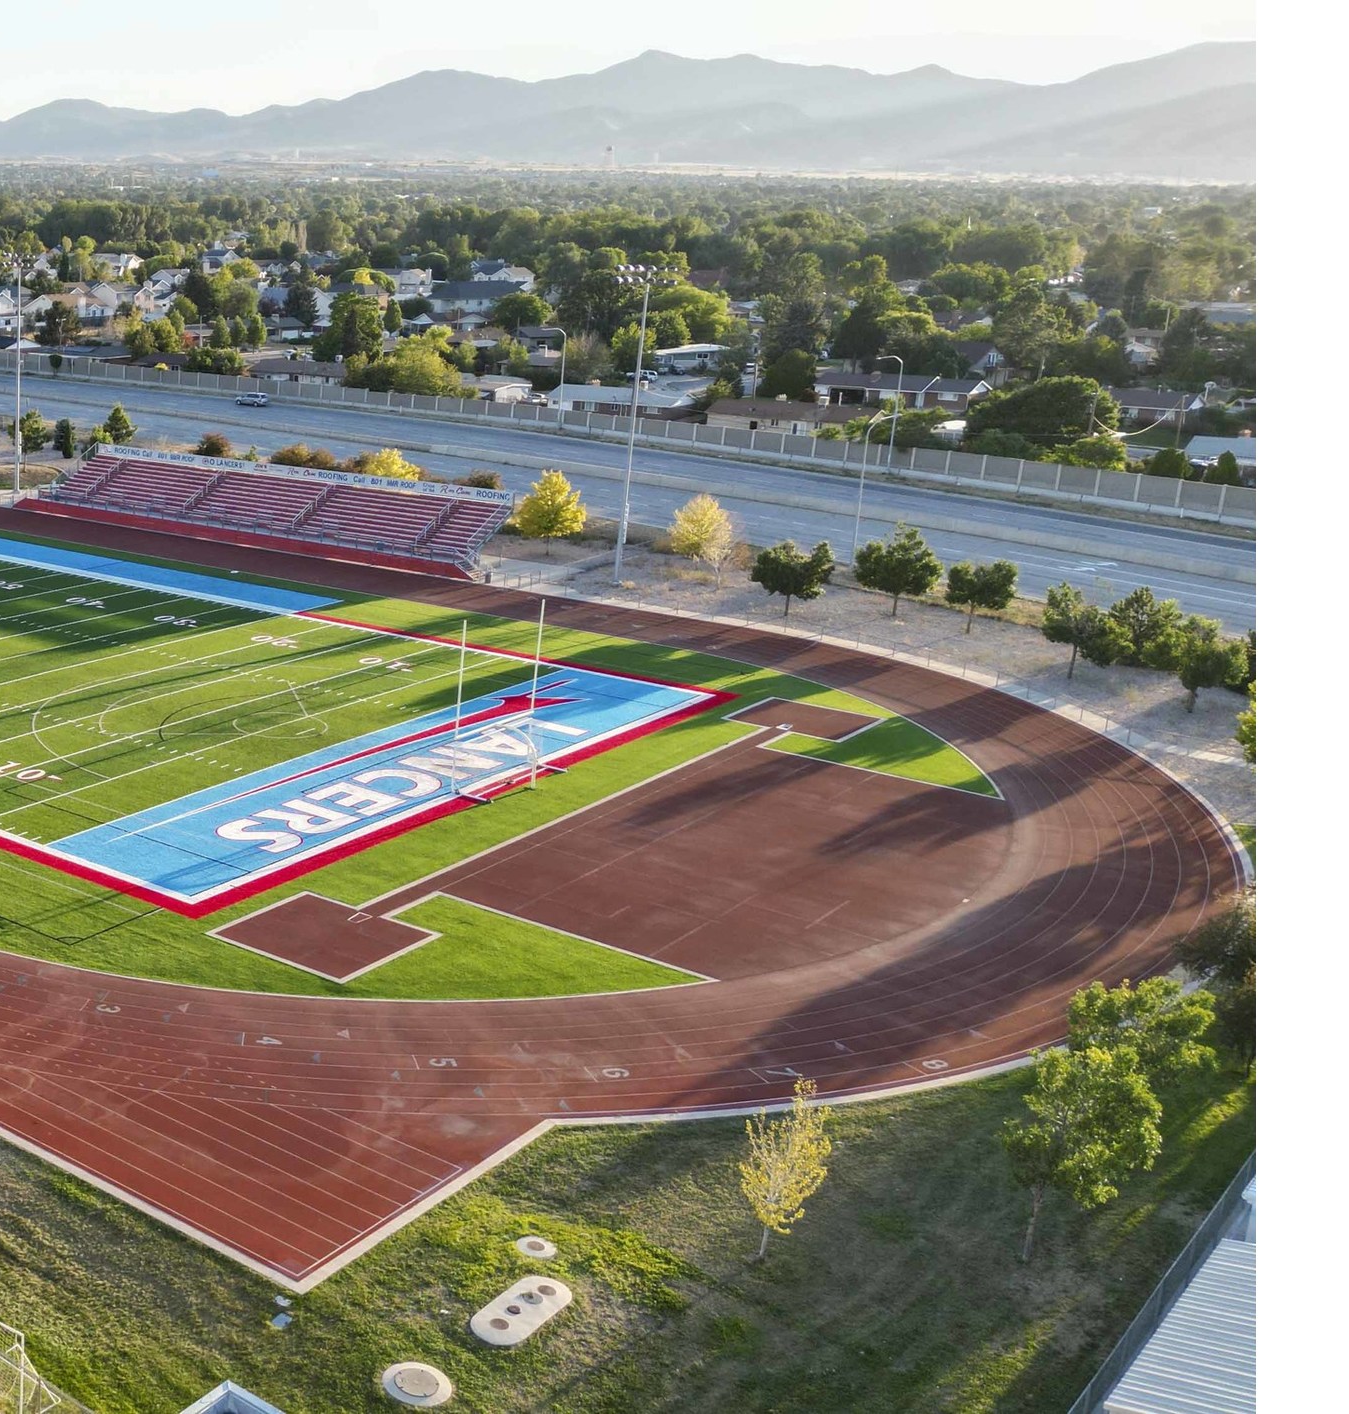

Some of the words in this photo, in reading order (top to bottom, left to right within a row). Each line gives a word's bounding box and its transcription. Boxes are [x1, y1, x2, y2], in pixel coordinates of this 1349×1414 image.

[114, 447, 140, 457] ROOFING
[318, 471, 348, 482] ROOFING
[353, 475, 366, 484] Call
[154, 615, 197, 626] 30
[250, 635, 298, 647] 20
[359, 656, 409, 671] 10
[215, 717, 589, 854] LANCERS
[96, 1003, 122, 1014] 3
[256, 1036, 283, 1045] 4
[429, 1057, 458, 1068] 5
[922, 1058, 949, 1070] 8
[601, 1067, 630, 1079] 6
